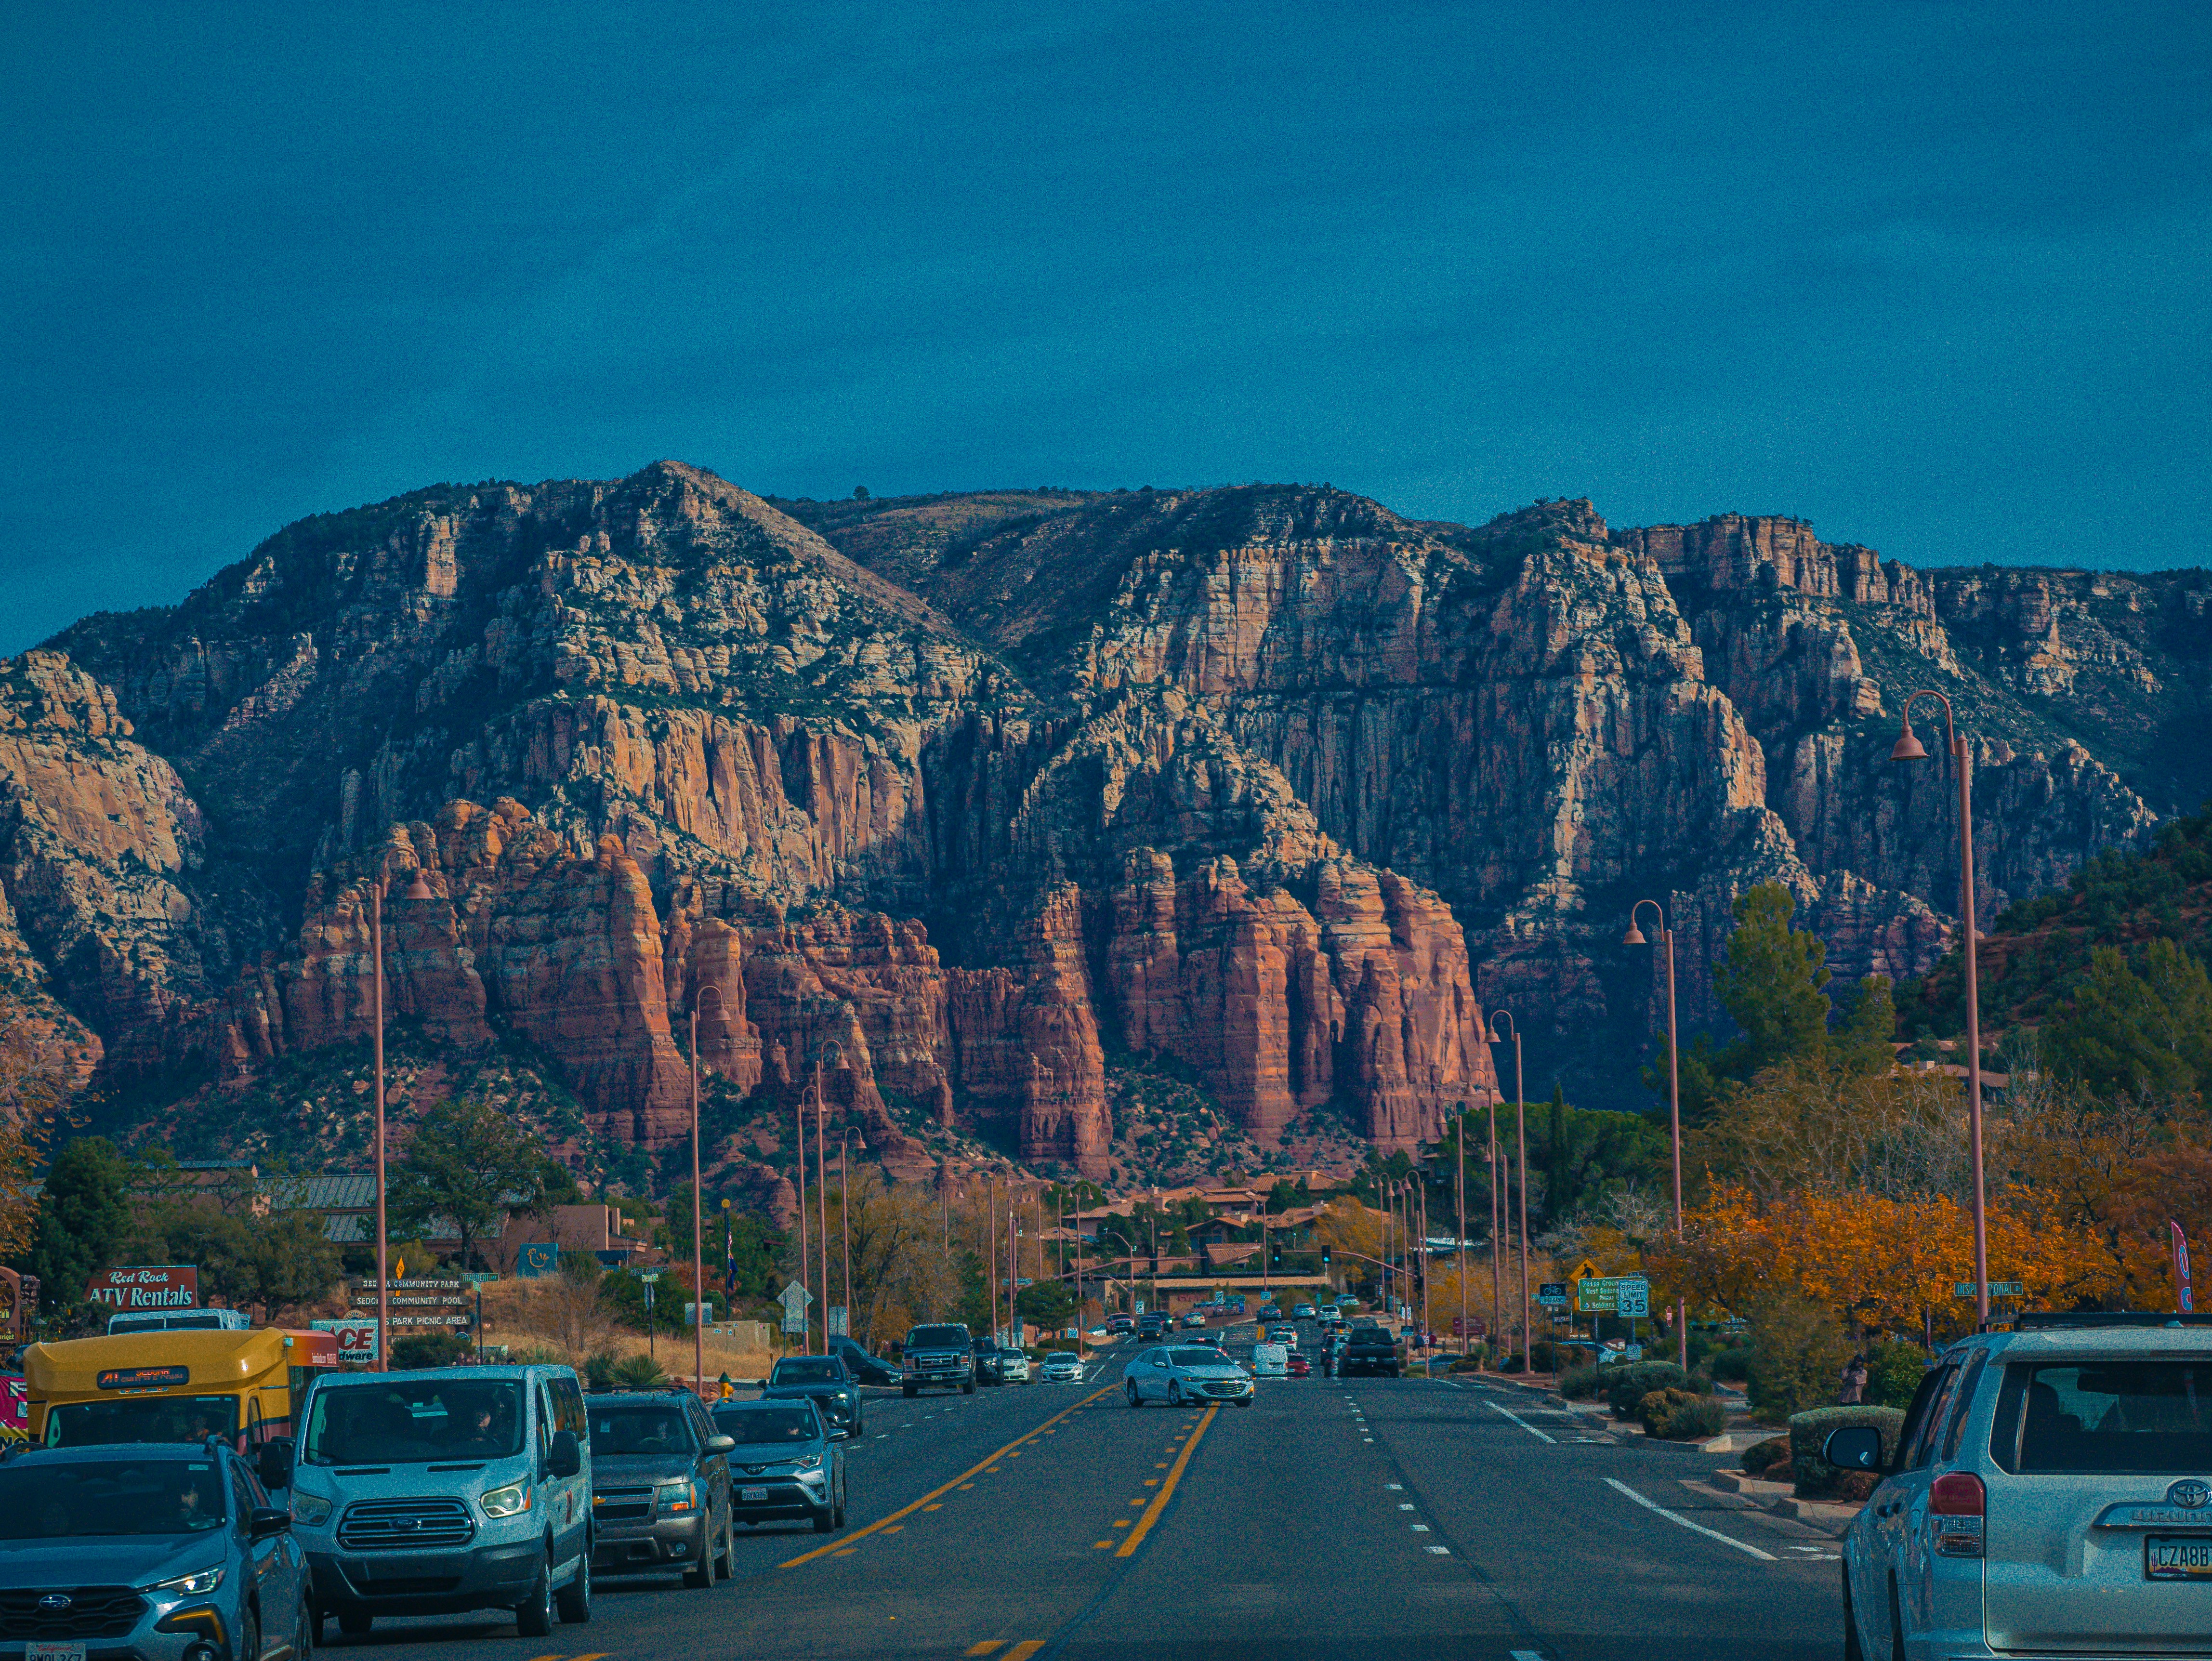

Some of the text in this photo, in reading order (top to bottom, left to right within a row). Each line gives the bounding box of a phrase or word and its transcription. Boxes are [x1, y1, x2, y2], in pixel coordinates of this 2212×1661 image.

[109, 1271, 169, 1284] Red Rock
[90, 1285, 192, 1306] ATV Rentals
[1621, 1299, 1646, 1312] 35
[393, 1317, 412, 1325] PARK
[329, 1326, 374, 1350] CE
[2159, 1545, 2212, 1567] CZA8B
